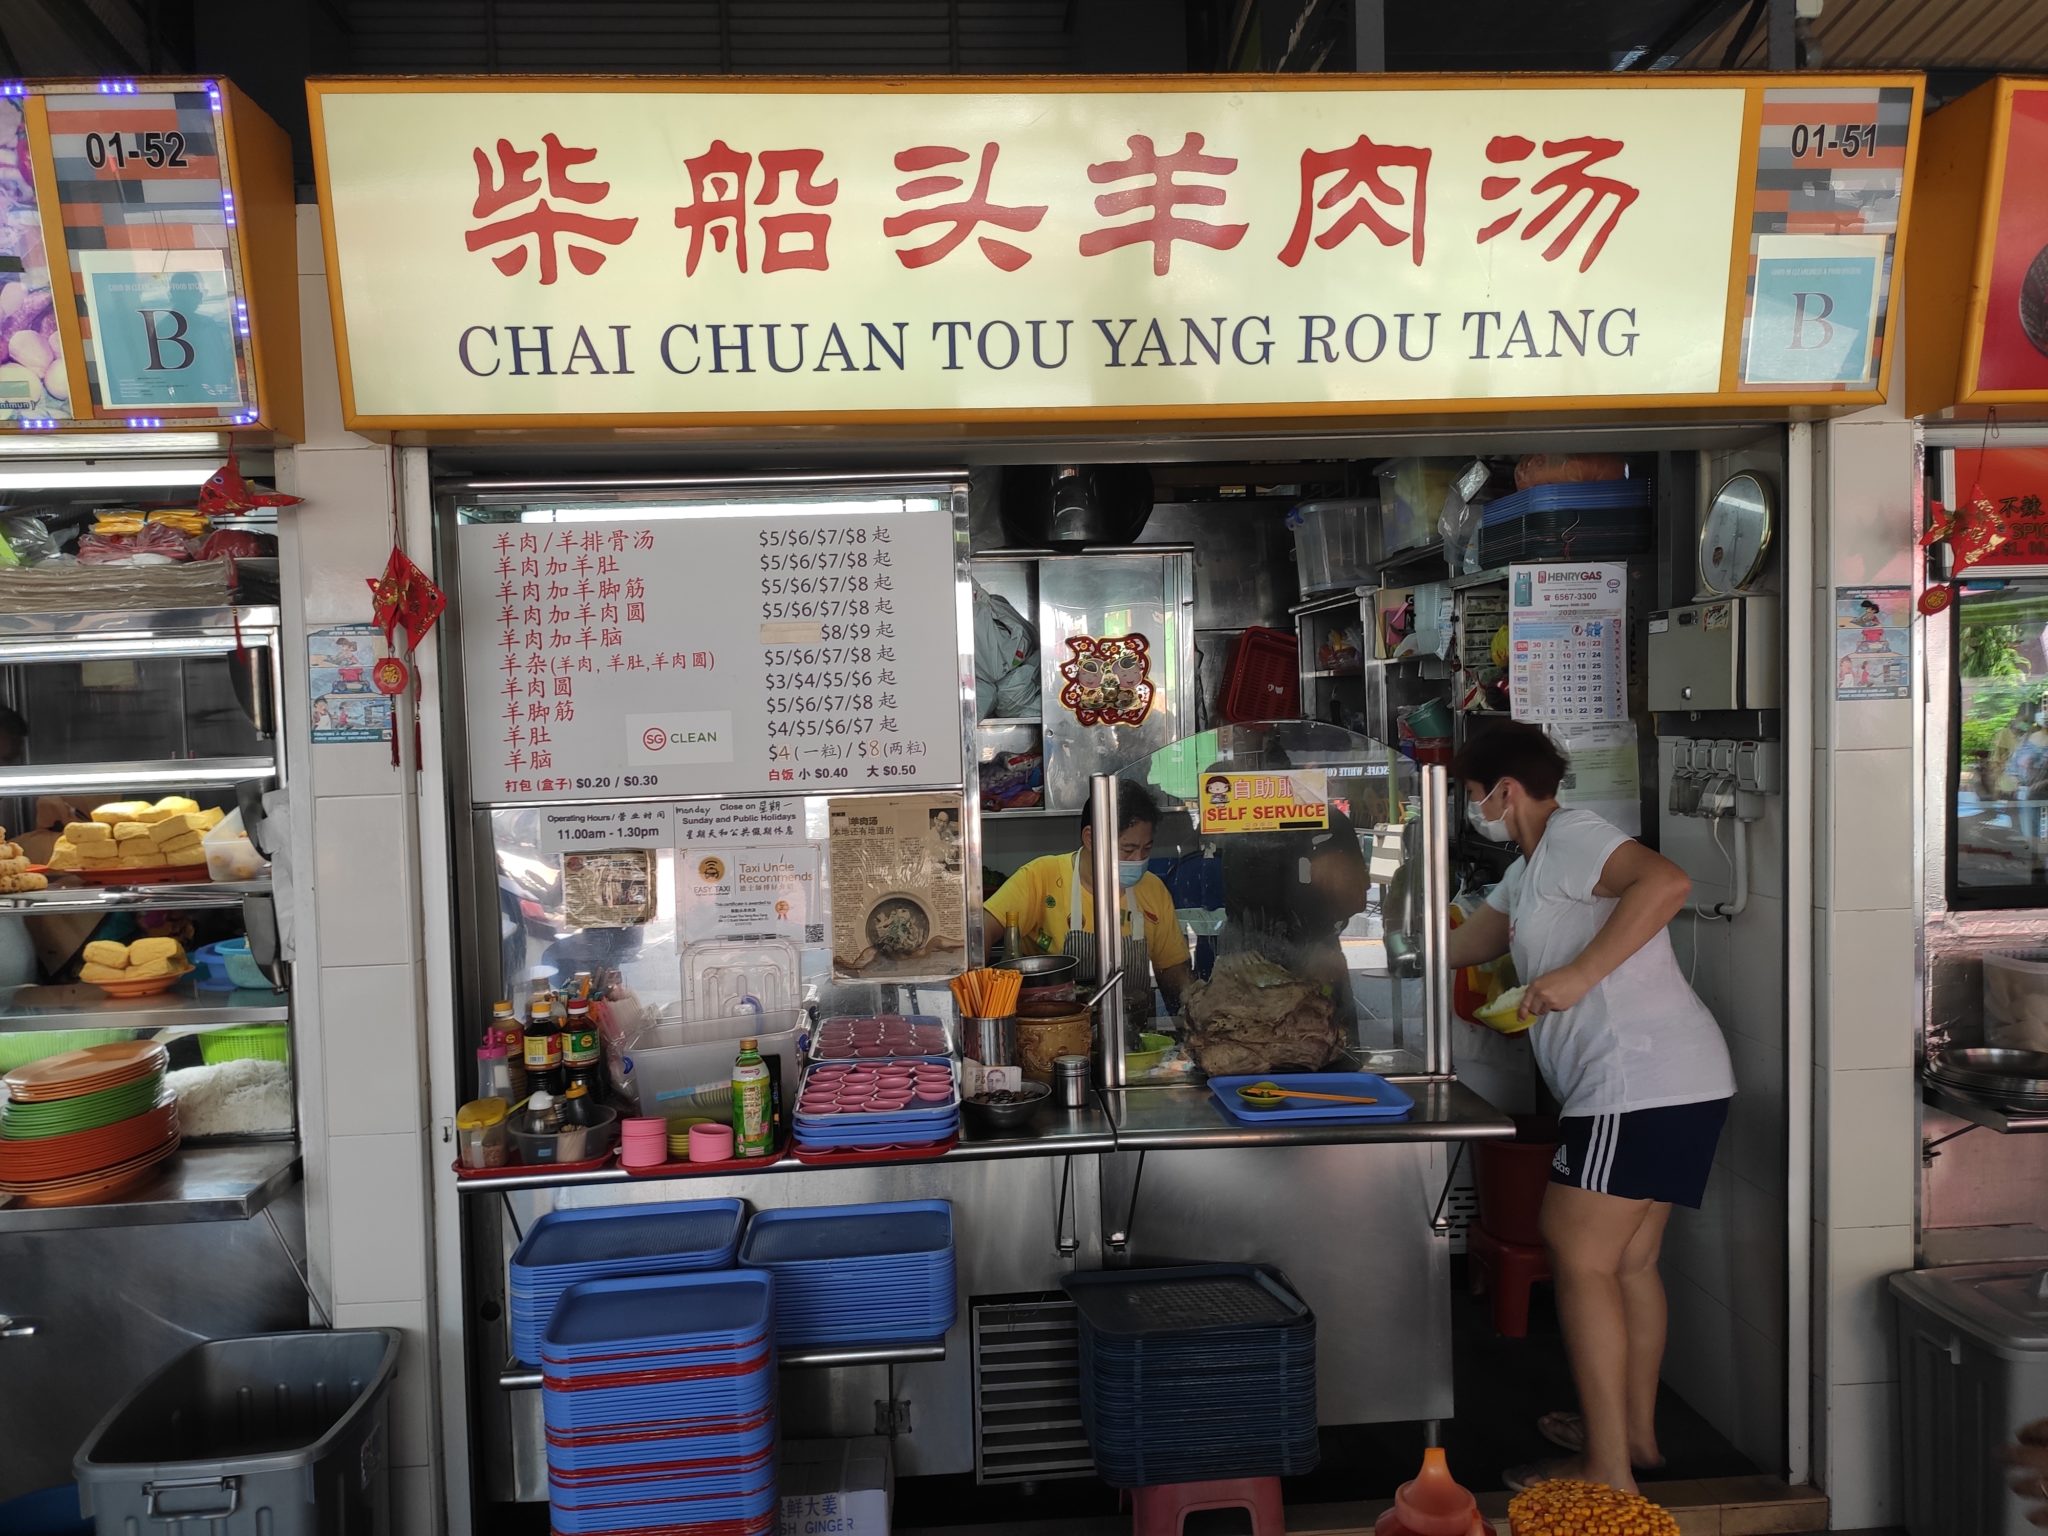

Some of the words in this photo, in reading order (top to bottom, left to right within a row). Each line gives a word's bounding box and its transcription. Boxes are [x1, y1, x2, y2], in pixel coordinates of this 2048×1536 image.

[86, 131, 188, 169] 01-52
[1790, 123, 1878, 158] 01-51
[465, 133, 1640, 285] 柴船头羊肉汤
[1785, 291, 1834, 350] B
[139, 308, 195, 371] B
[458, 325, 635, 376] CHAI
[661, 322, 909, 374] CHUAN
[931, 319, 1075, 371] TOU
[1092, 315, 1275, 367] YANG
[1297, 312, 1441, 363] ROU
[1463, 307, 1640, 360] TANG
[492, 529, 655, 556] 羊肉/羊排骨汤
[759, 528, 867, 548] $5/$6/$7/$8
[872, 525, 893, 543] 起
[494, 553, 620, 579] 羊肉加羊肚
[760, 551, 867, 572] $5/$6/$7/$8
[873, 549, 893, 567] 起
[761, 575, 868, 596] $5/$6/$7/$8
[874, 573, 894, 591] 起
[1548, 571, 1602, 581] HENRYGAS
[496, 577, 645, 603] 羊肉加羊脚筋
[496, 601, 645, 628] 羊肉加羊肉圆
[762, 599, 869, 619] $5/$6/$7/$8
[875, 597, 895, 615] 起
[498, 626, 622, 652] 羊肉加羊脑
[821, 623, 870, 641] $8/$9
[875, 621, 896, 638] 起
[764, 647, 871, 667] $5/$6/$7/$8
[877, 644, 897, 662] 起
[501, 676, 572, 700] 羊肉圆
[765, 670, 872, 691] $3/$4/$5/$6
[877, 668, 898, 685] 起
[502, 700, 575, 725] 羊脚筋
[766, 694, 873, 714] $5/$6/$7/$8
[878, 691, 898, 709] 起
[503, 725, 552, 749] 羊肚
[768, 717, 874, 738] $4/$5/$6/$7
[879, 715, 900, 732] 起
[646, 734, 663, 745] SG
[670, 732, 717, 744] CLEAN
[504, 749, 552, 773] 羊脑
[768, 744, 790, 762] $4
[858, 740, 879, 759] $8
[505, 779, 532, 792] 打包
[537, 777, 573, 791] (盒子)
[576, 776, 611, 789] $0.20
[623, 775, 658, 788] $0.30
[769, 768, 794, 781] 白饭
[799, 768, 810, 780] 小
[815, 767, 848, 779] $0.40
[867, 765, 879, 778] 大
[883, 765, 916, 776] $0.50
[547, 814, 585, 823] Operating
[587, 814, 610, 822] Hours
[720, 803, 743, 811] Close
[1207, 807, 1247, 821] SELF
[1253, 804, 1326, 819] SERVICE
[682, 817, 713, 825] Sunday
[715, 815, 731, 823] and
[733, 814, 758, 822] Public
[761, 813, 796, 822] Holidays
[558, 829, 605, 839] 11.00am
[617, 827, 659, 839] 1.30pm
[739, 863, 760, 873] Taxi
[763, 862, 794, 872] Uncle
[739, 872, 813, 883] Recommends
